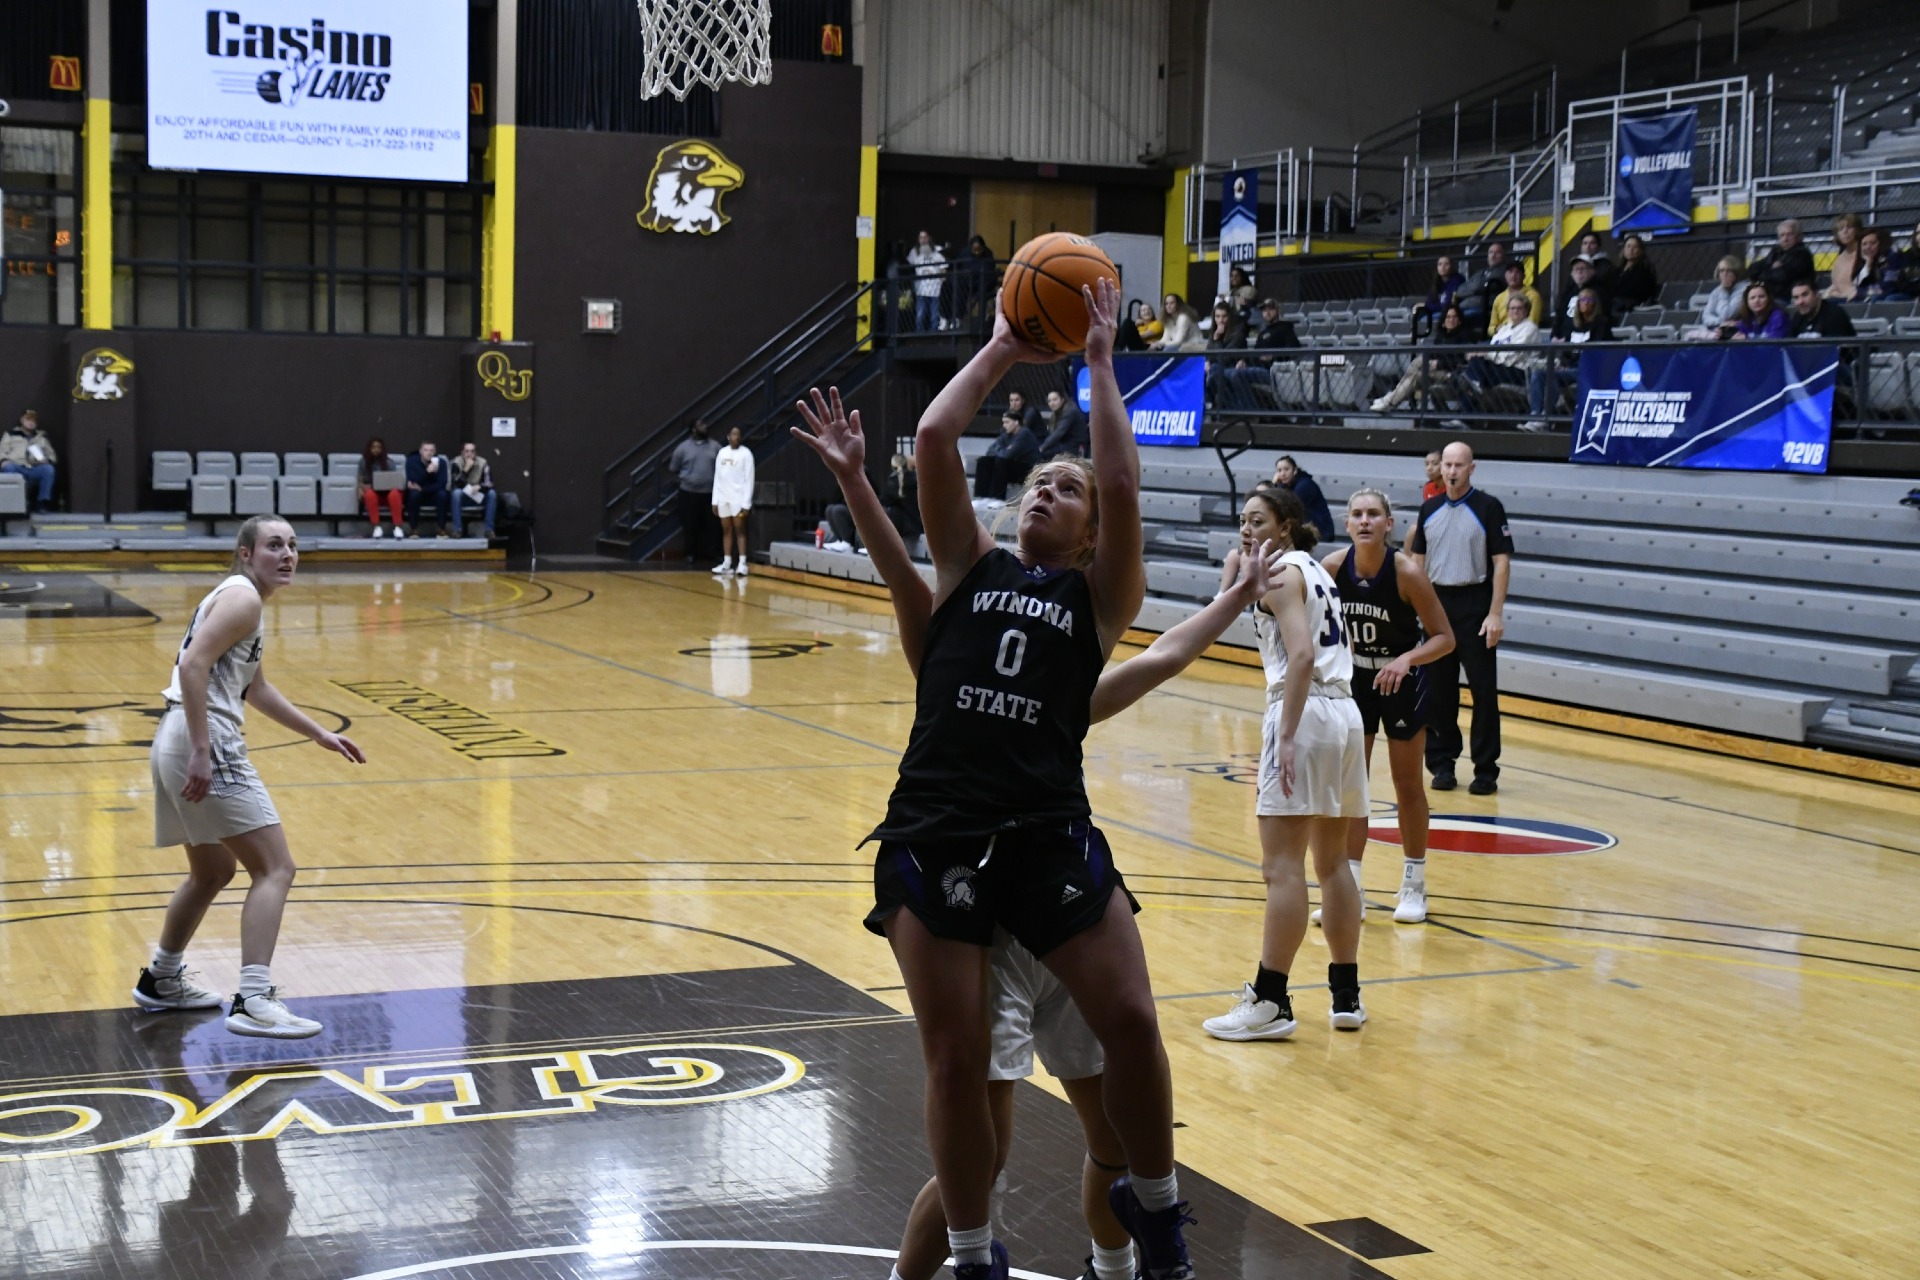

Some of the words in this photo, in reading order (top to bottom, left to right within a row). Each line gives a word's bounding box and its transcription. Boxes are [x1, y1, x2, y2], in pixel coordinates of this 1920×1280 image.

[206, 10, 391, 68] Casino
[307, 69, 391, 102] LANES
[155, 115, 195, 127] ENJOY
[198, 115, 276, 131] AFFORDABLE
[280, 120, 304, 132] FUN
[308, 123, 337, 133] WITH
[341, 124, 380, 135] FAMILY
[383, 127, 408, 137] AND
[411, 128, 461, 140] FRIENDS
[183, 129, 213, 140] 20TH
[216, 131, 240, 142] AND
[1633, 150, 1692, 174] VOLLEYBALL
[1222, 243, 1254, 264] UNITED
[1131, 410, 1196, 436] VOLLEYBALL
[1615, 402, 1686, 423] VOLLEYBALL
[1611, 423, 1675, 438] CHAMPIONSHIP
[972, 591, 1073, 637] WINONA
[1351, 621, 1376, 643] 10
[994, 628, 1028, 677] 0
[956, 684, 1042, 725] STATE
[1060, 890, 1083, 905] adidas
